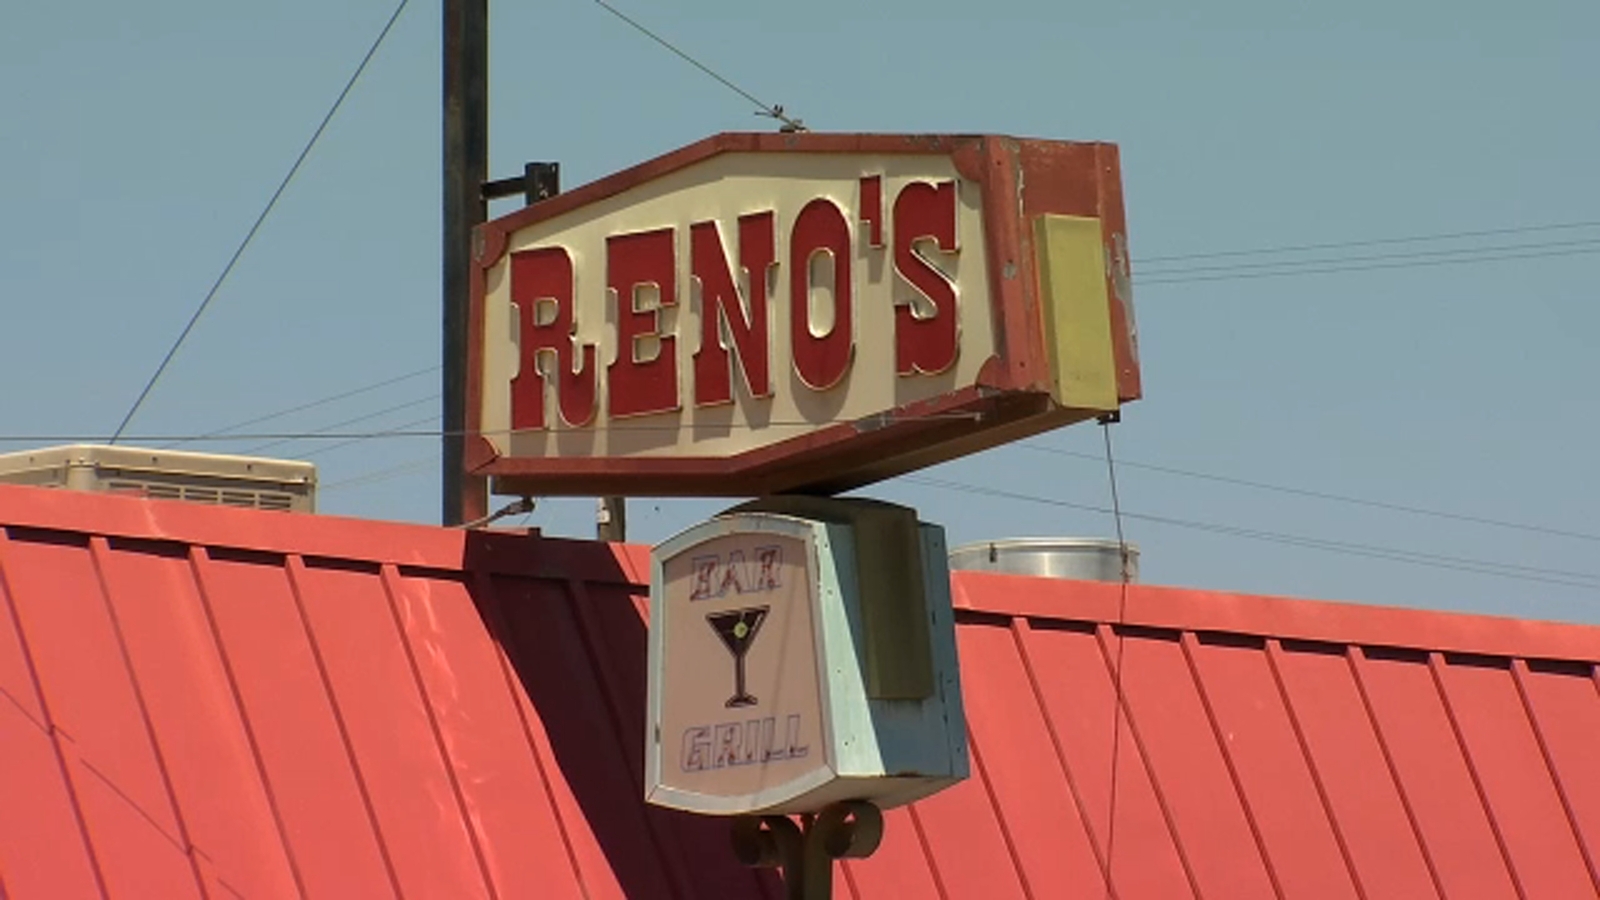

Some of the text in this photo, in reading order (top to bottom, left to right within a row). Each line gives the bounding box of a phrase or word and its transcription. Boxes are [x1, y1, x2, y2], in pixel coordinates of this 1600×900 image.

[509, 173, 960, 430] RENO'S
[690, 544, 783, 601] BAR
[680, 713, 809, 773] GRILL
